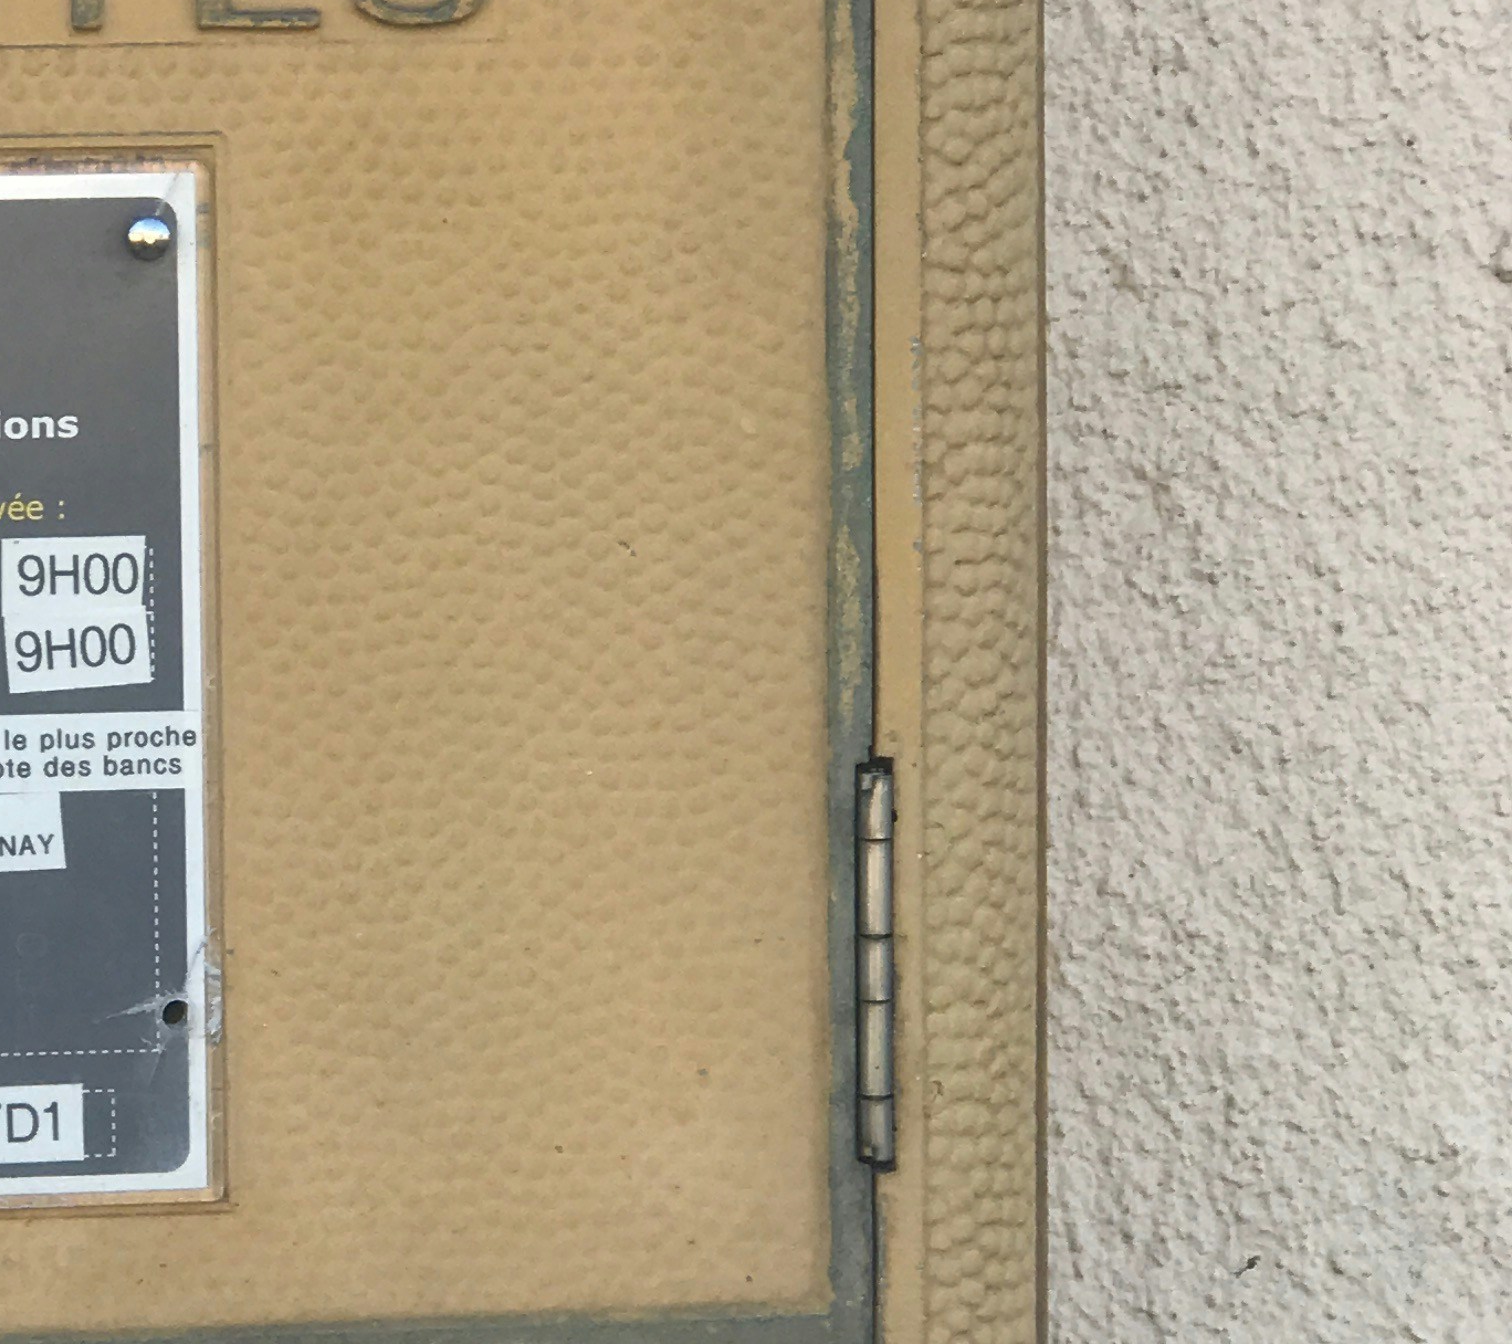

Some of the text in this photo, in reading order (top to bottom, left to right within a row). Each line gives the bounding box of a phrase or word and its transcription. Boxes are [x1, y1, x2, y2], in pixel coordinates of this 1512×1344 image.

[16, 551, 140, 597] 9H00
[15, 622, 137, 673] 9H00
[4, 728, 27, 752] le
[40, 728, 95, 753] plus
[107, 725, 197, 752] proche
[43, 755, 92, 778] des
[103, 753, 183, 777] bancs
